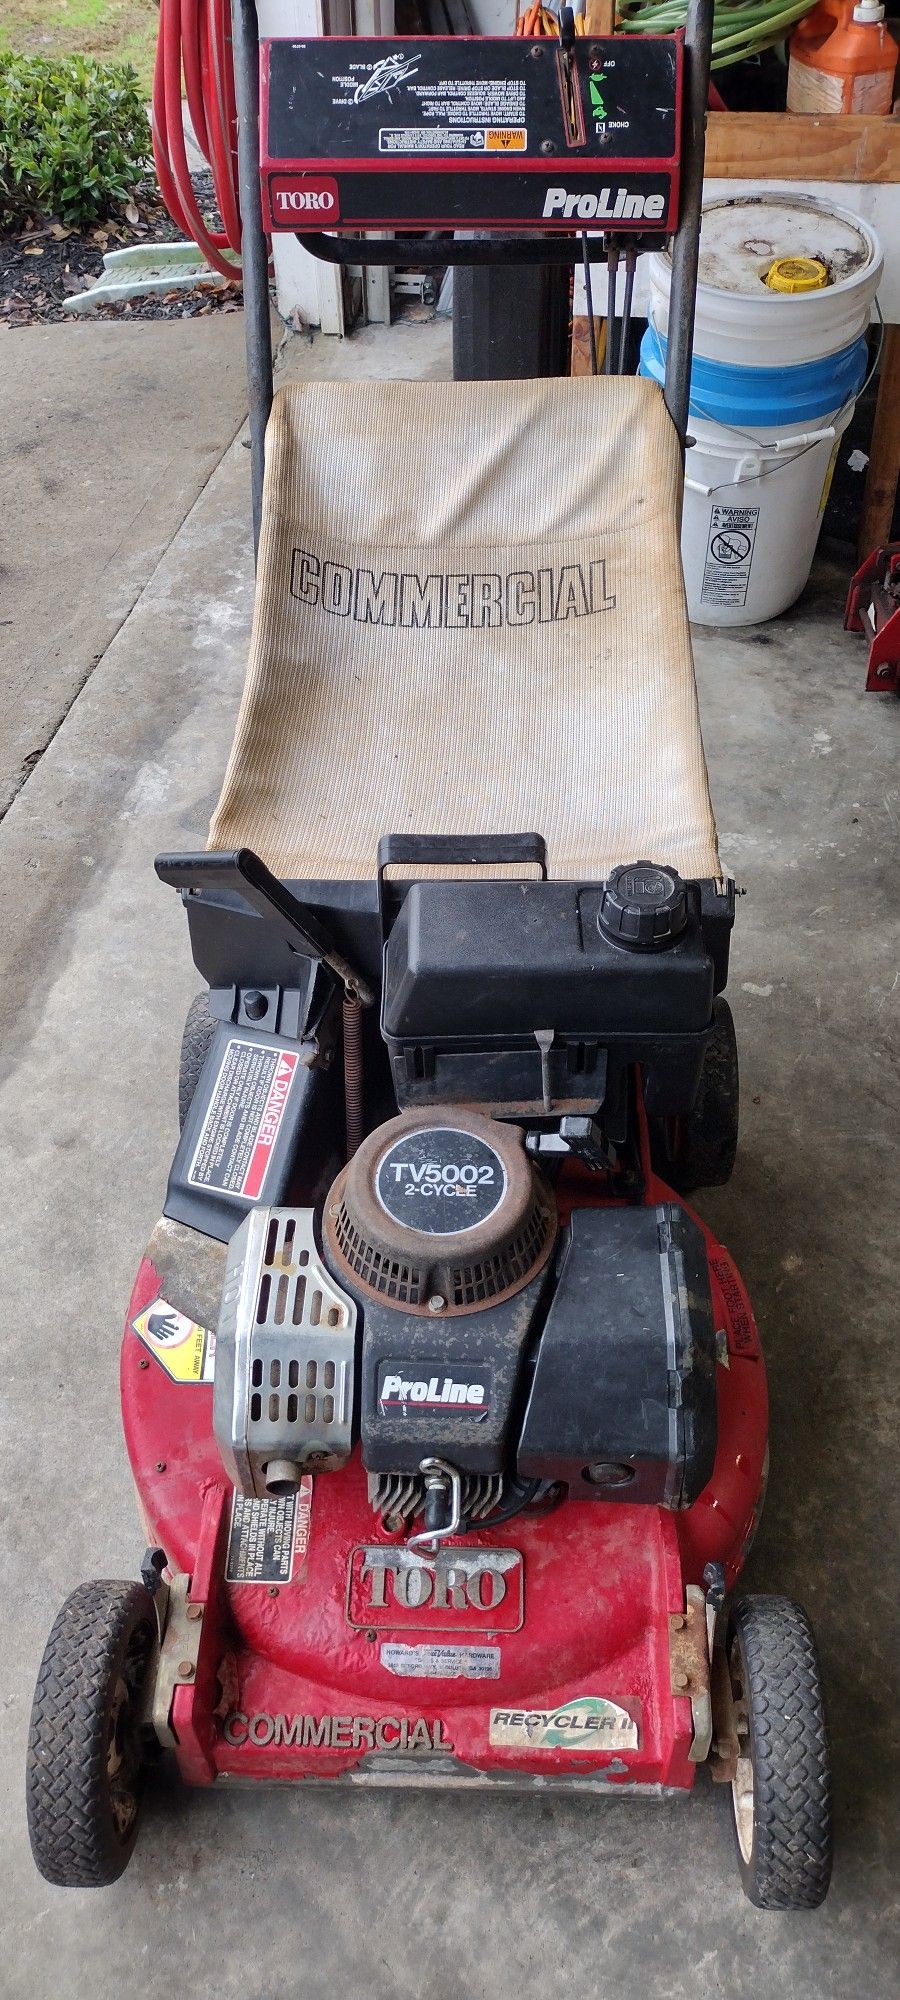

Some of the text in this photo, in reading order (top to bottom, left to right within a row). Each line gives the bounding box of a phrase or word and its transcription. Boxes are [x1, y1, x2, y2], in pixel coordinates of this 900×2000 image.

[488, 131, 523, 139] WARNING
[276, 187, 664, 218] TORO ProLine
[722, 508, 757, 516] WARNING
[290, 548, 616, 628] COMMERCIAL
[223, 1048, 234, 1071] MOVING
[234, 1051, 246, 1075] CLOSED
[239, 1052, 252, 1079] OPERATE
[259, 1056, 270, 1079] RESULT
[217, 1072, 227, 1090] DOOR
[232, 1075, 239, 1084] OR
[235, 1080, 244, 1095] ONLY
[237, 1053, 258, 1110] SERIOUSLY INJURE.
[210, 1090, 222, 1114] HANDLE
[220, 1084, 236, 1123] ATTACHMENT
[252, 1085, 262, 1103] DOOR
[196, 1049, 240, 1181] CLEAR DISCHARGE WITH ENGINE STOPPED BY
[205, 1114, 215, 1132] BACK
[221, 1054, 264, 1186] THROWN OBJECTS AND BLADE CONTACT CAN
[227, 1102, 237, 1120] DOOR
[234, 1057, 276, 1189] THROWN OBJECTS AND BLADE CONTACT MAY
[246, 1110, 255, 1123] NOT
[258, 1079, 287, 1146] DANGER
[201, 1132, 209, 1146] AND
[211, 1129, 223, 1154] LOCKED
[214, 1127, 230, 1167] COMPLETELY
[235, 1123, 251, 1163] COMPLETELY
[389, 1162, 495, 1185] TV5002
[404, 1183, 478, 1197] 2-CYCLE
[709, 1258, 744, 1350] PLACE FOOT HERE
[720, 1257, 752, 1343] WHEN STARTING
[195, 1334, 203, 1352] FEET
[193, 1356, 201, 1374] AWAY
[381, 1375, 485, 1404] ProLine
[233, 1503, 243, 1528] PLACE.
[242, 1507, 251, 1522] AND
[266, 1506, 277, 1534] INJURE.
[284, 1501, 294, 1518] WITH
[248, 1511, 259, 1542] SHIELDS
[253, 1498, 269, 1576] PERATE WITHOUT ALL
[273, 1510, 285, 1543] OBJECTS
[281, 1520, 292, 1548] MOVING
[293, 1503, 309, 1552] DANGER
[237, 1524, 249, 1577] ATTACHMENTS
[248, 1543, 255, 1551] IN
[272, 1544, 281, 1560] CAN
[245, 1552, 255, 1576] PLACE
[279, 1550, 289, 1574] PARTS
[360, 1565, 506, 1611] TORO
[386, 1649, 419, 1657] HOWARD'S
[224, 1712, 454, 1751] COMMERCIAL
[493, 1712, 616, 1730] RECYCLER
